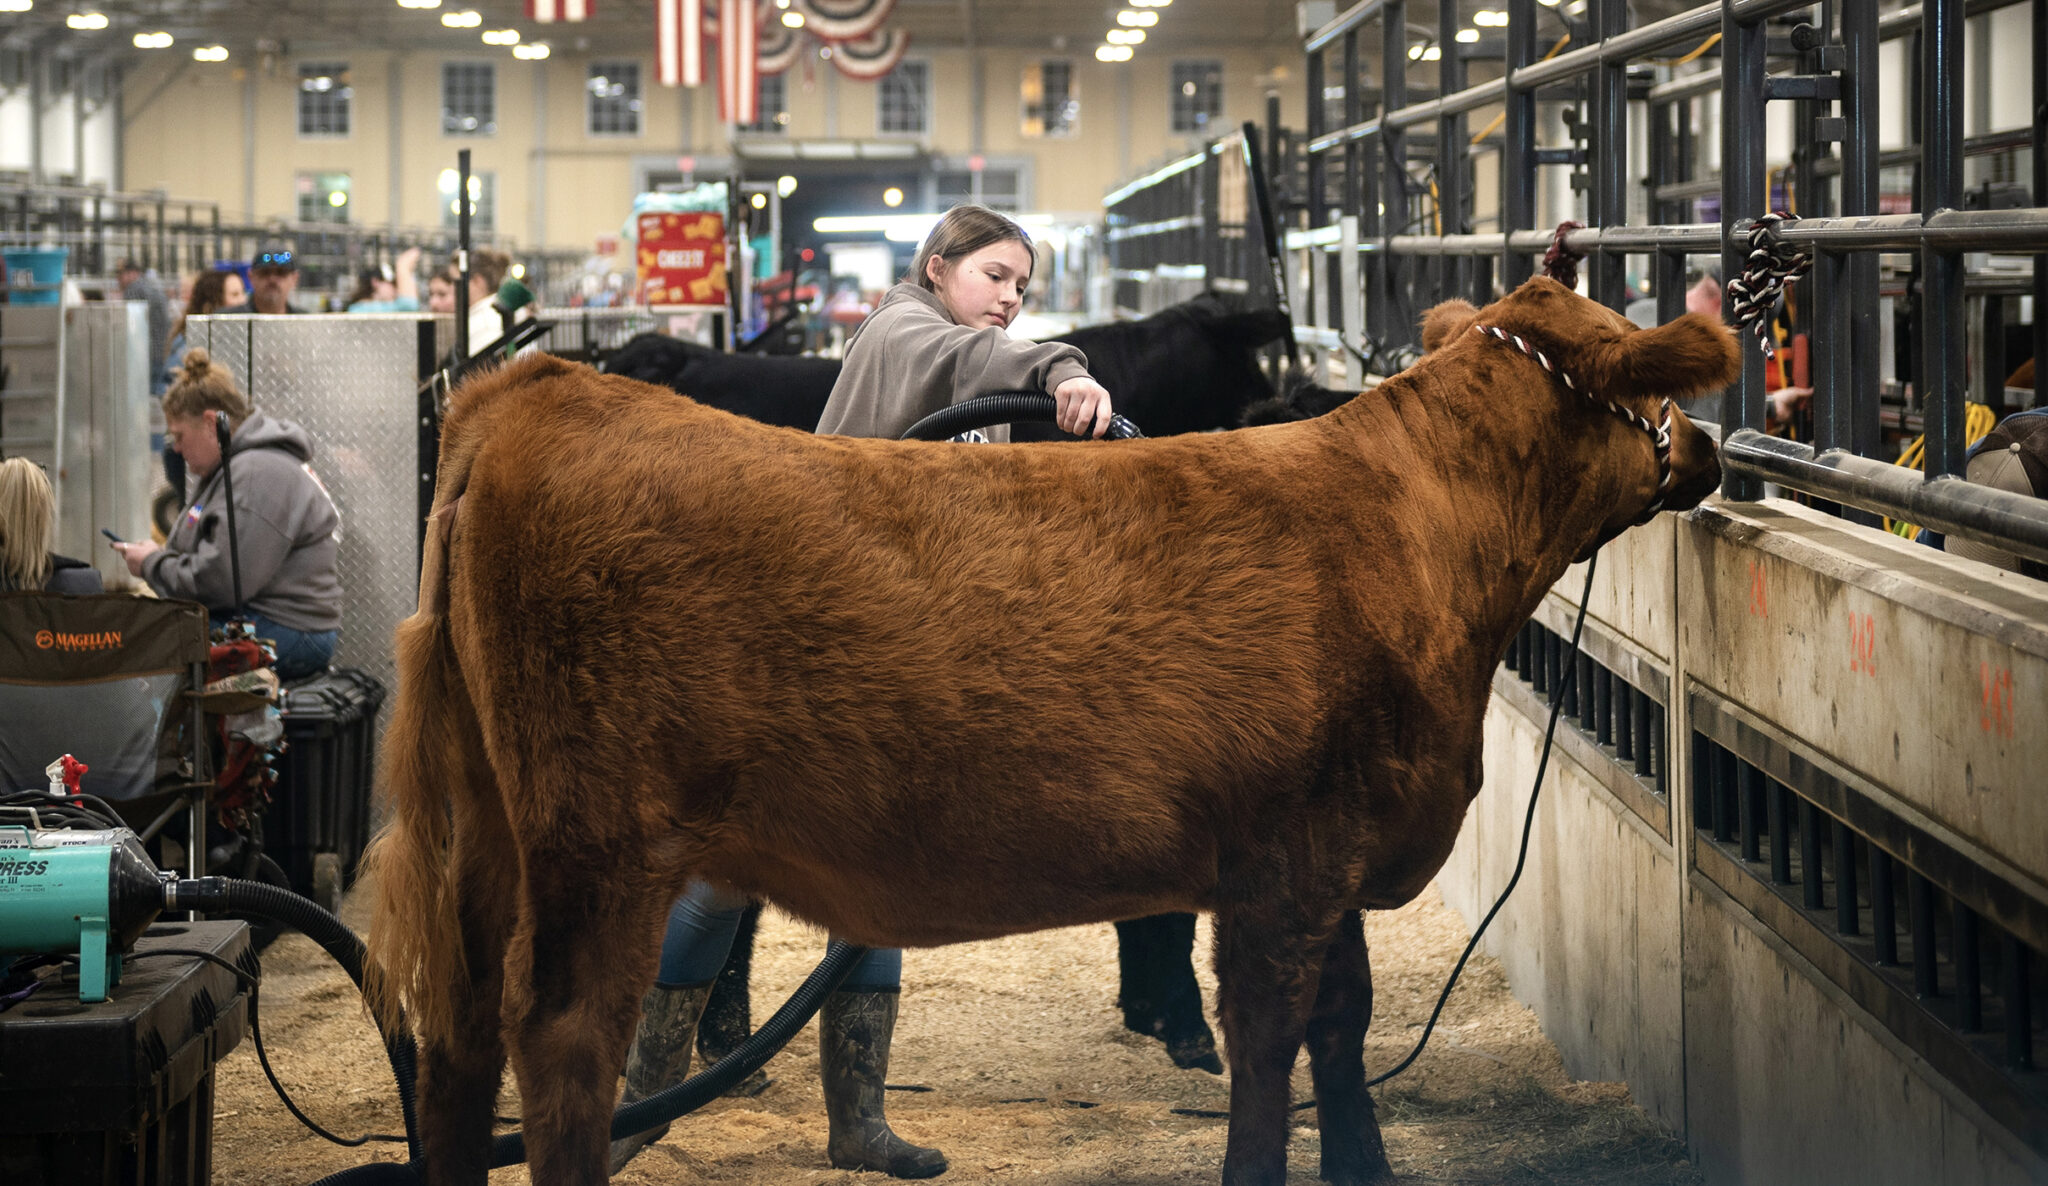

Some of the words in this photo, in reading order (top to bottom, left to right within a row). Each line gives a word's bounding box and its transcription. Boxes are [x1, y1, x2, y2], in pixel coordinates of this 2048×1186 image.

[56, 631, 122, 648] MAGELLAN
[1848, 610, 1876, 678] 242
[1979, 660, 2015, 740] 243
